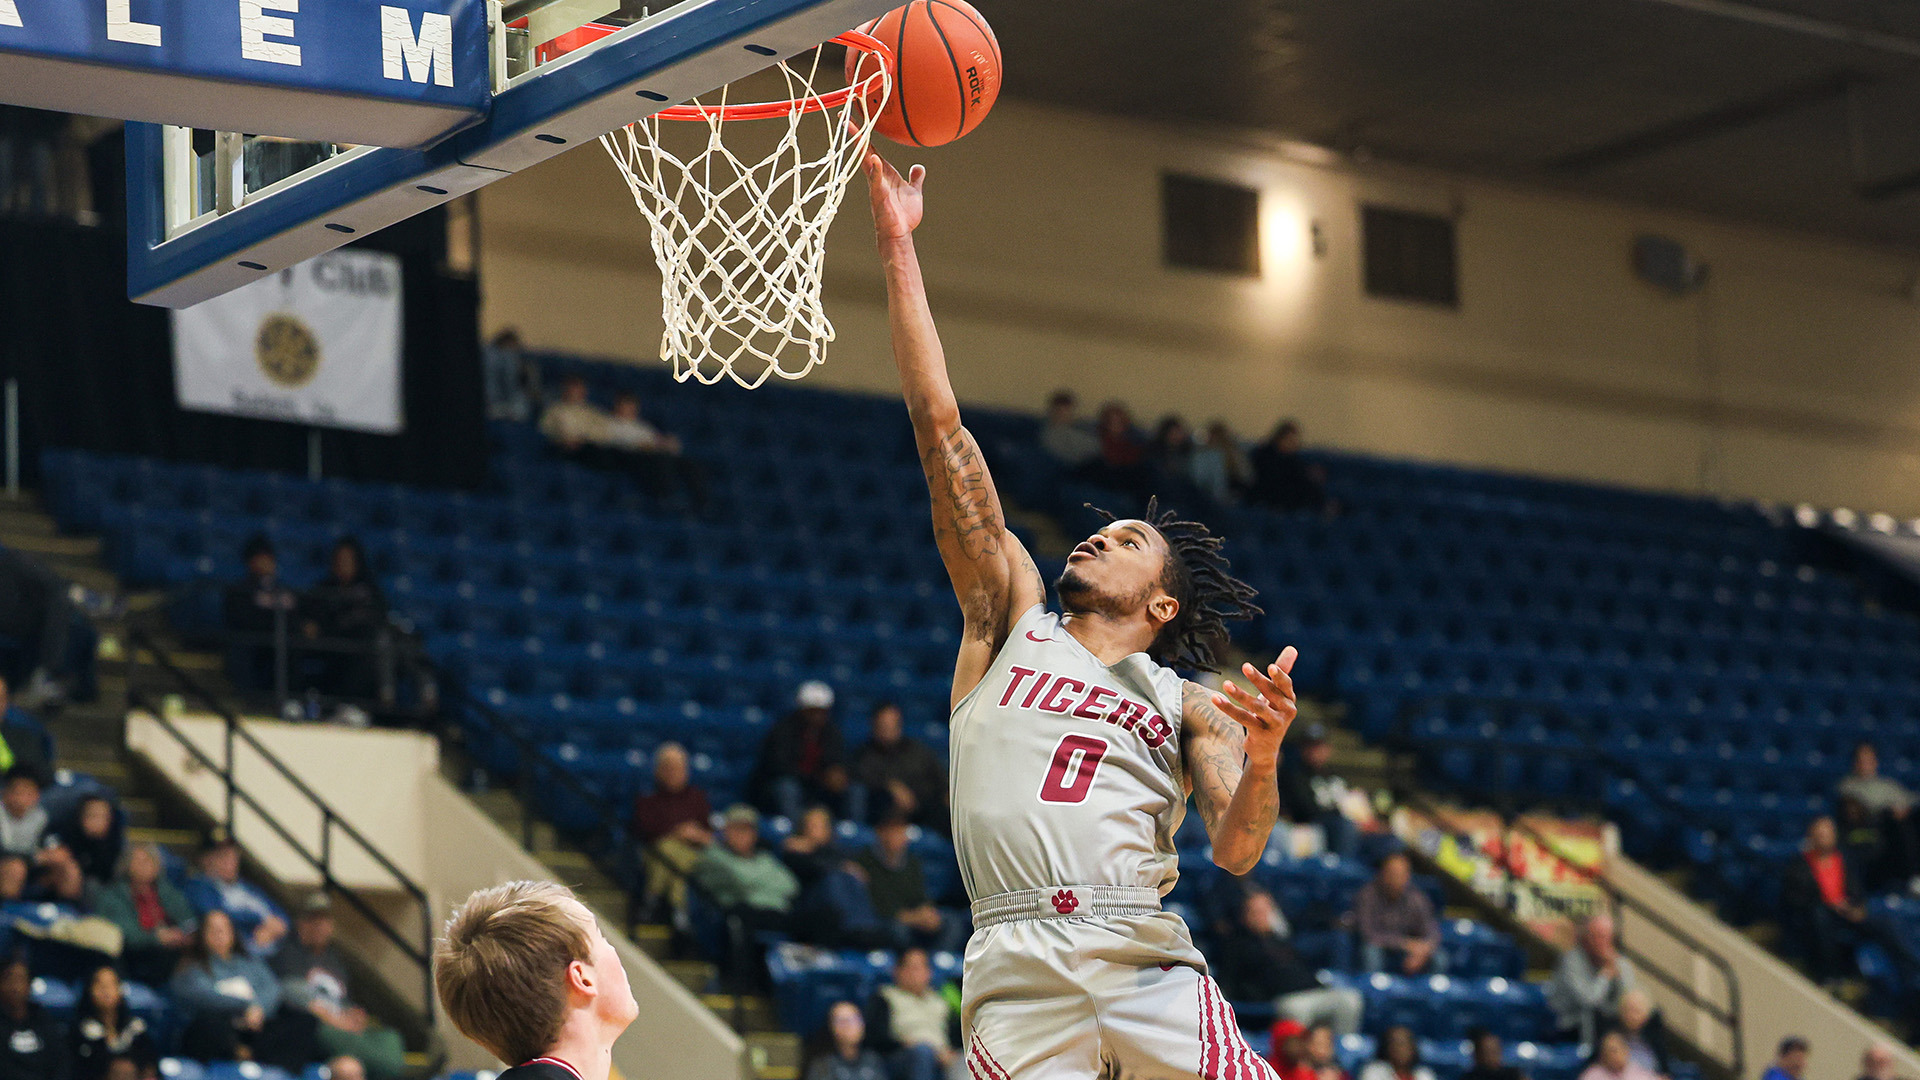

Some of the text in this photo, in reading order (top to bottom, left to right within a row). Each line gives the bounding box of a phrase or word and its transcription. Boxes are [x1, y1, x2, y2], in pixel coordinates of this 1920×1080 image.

[0, 0, 453, 87] LEM
[966, 66, 981, 107] ROCK
[997, 664, 1174, 749] TIGERS
[1037, 731, 1111, 806] 0
